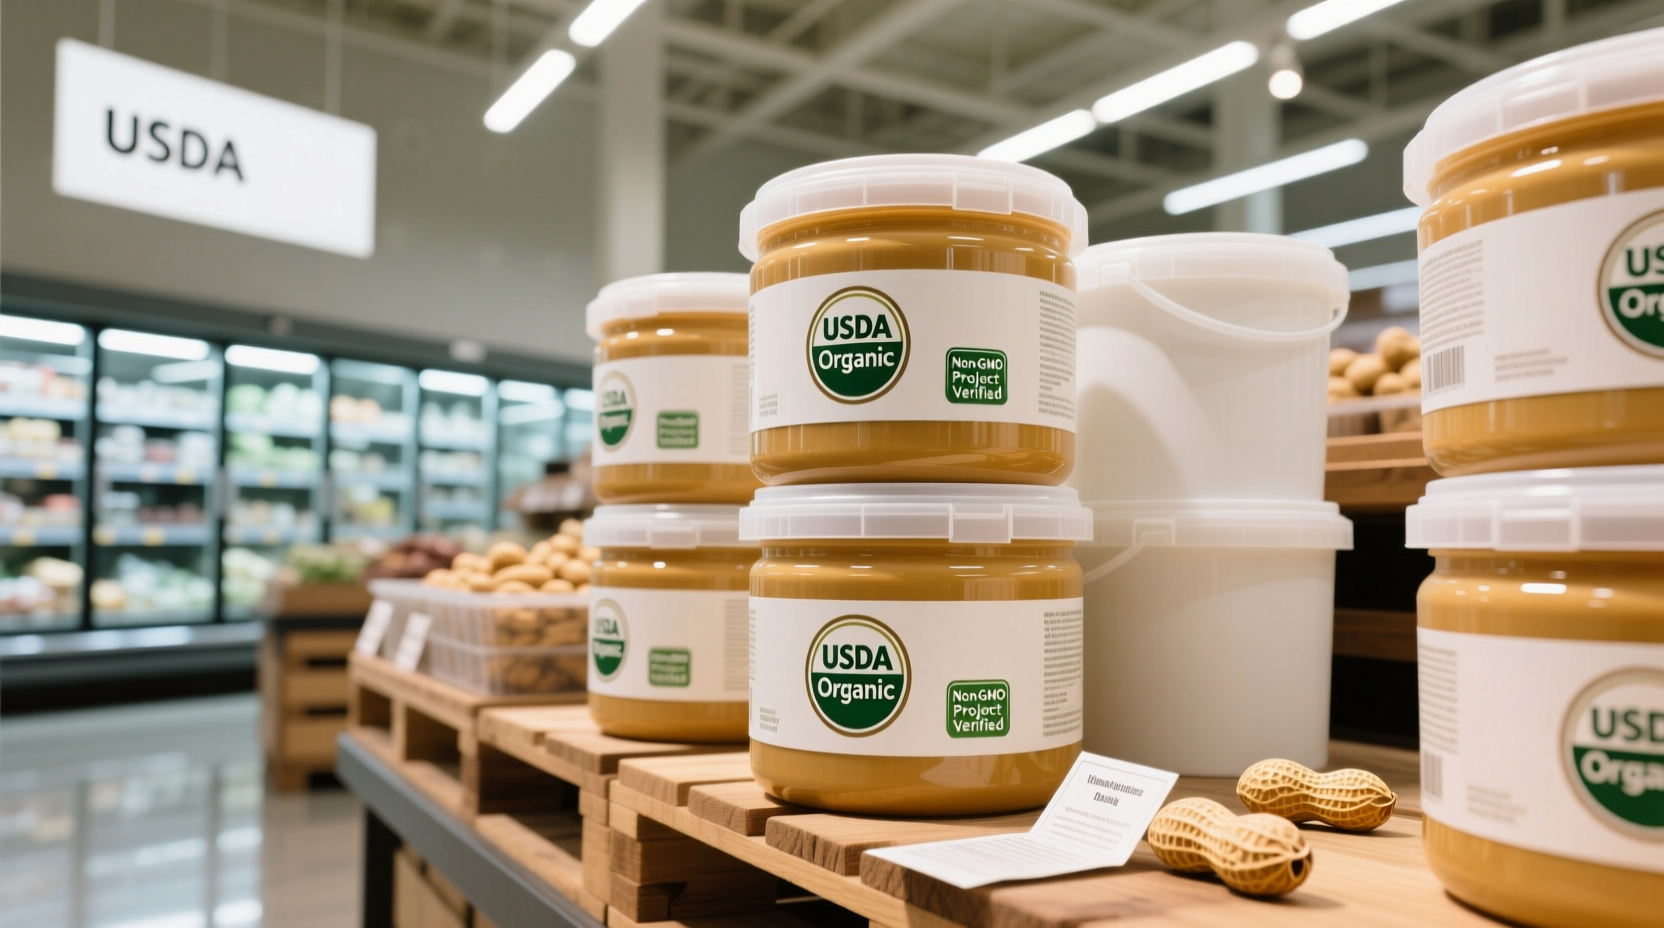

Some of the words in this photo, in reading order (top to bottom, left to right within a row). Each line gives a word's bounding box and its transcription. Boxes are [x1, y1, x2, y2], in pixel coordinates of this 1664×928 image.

[106, 109, 244, 182] USDA
[822, 314, 893, 341] USDA
[818, 346, 895, 374] Organic
[822, 644, 894, 672] USDA
[817, 678, 895, 704] Organic
